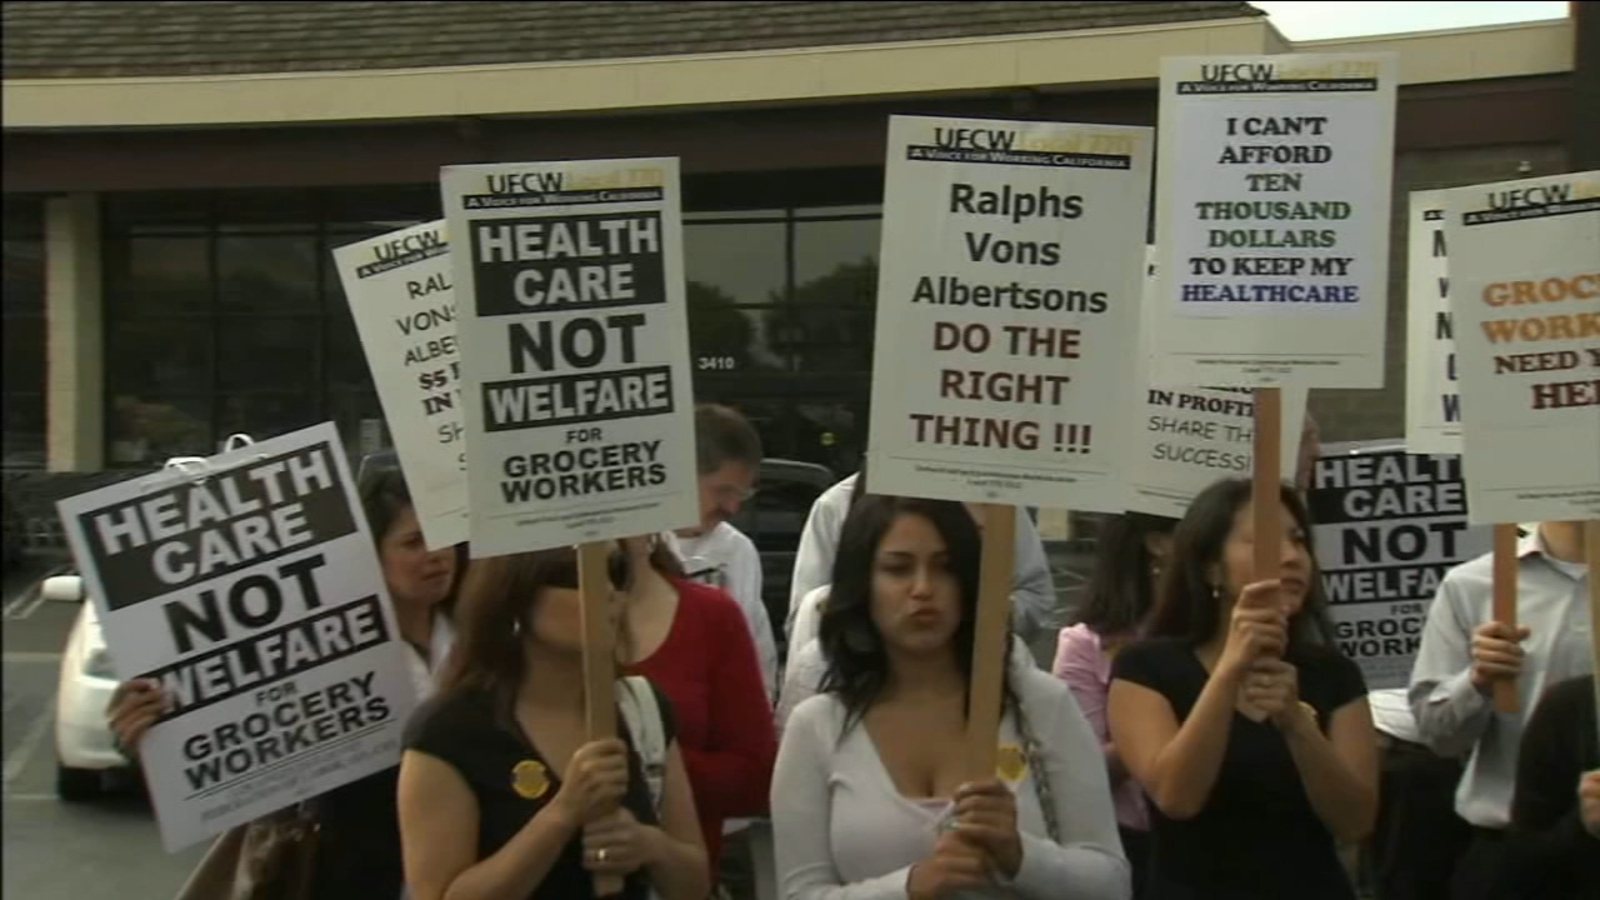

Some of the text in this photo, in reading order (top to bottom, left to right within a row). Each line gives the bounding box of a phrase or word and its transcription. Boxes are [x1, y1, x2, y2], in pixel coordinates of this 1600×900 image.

[1201, 63, 1273, 82] UFCW
[934, 127, 1016, 150] UFCW
[1226, 117, 1329, 136] I CAN'T
[1053, 154, 1126, 168] CALIFORNIA
[1217, 145, 1332, 164] AFFORD
[487, 172, 563, 193] UFCW
[1245, 173, 1303, 192] TEN
[1488, 183, 1570, 210] UFCW
[949, 182, 1083, 224] Ralphs
[1194, 201, 1351, 220] THOUSAND
[373, 230, 439, 262] UFCW
[478, 216, 658, 263] HEALTH
[964, 231, 1060, 266] Vons
[1208, 229, 1336, 248] DOLLARS
[1189, 257, 1355, 276] TO KEEP MY
[407, 273, 453, 299] RAL
[514, 263, 636, 306] CARE
[912, 276, 1108, 313] Albertsons
[1181, 285, 1360, 303] HEALTHCARE
[1482, 272, 1600, 307] GROC
[508, 313, 646, 374] NOT
[933, 321, 1081, 359] DO THE
[698, 356, 735, 369] 3410
[1493, 350, 1579, 374] NEED
[419, 369, 447, 390] $5
[940, 369, 1070, 405] RIGHT
[422, 392, 454, 416] IN
[488, 372, 669, 424] WELFARE
[1147, 389, 1174, 405] IN
[566, 427, 602, 444] FOR
[909, 413, 1092, 454] THING !!!
[1147, 416, 1218, 440] SHARE
[504, 440, 661, 478] GROCERY
[1316, 453, 1461, 489] HEALT
[501, 463, 667, 503] WORKERS
[95, 449, 333, 555] HEALTH
[1343, 482, 1464, 518] CARE
[152, 503, 314, 585] CARE
[1342, 521, 1467, 565] NOT
[163, 553, 326, 653] NOT
[1391, 603, 1423, 615] FOR
[157, 601, 379, 713] WELFARE
[255, 681, 298, 706] FOR
[183, 671, 376, 762] GROCERY
[184, 697, 391, 790] WORKERS
